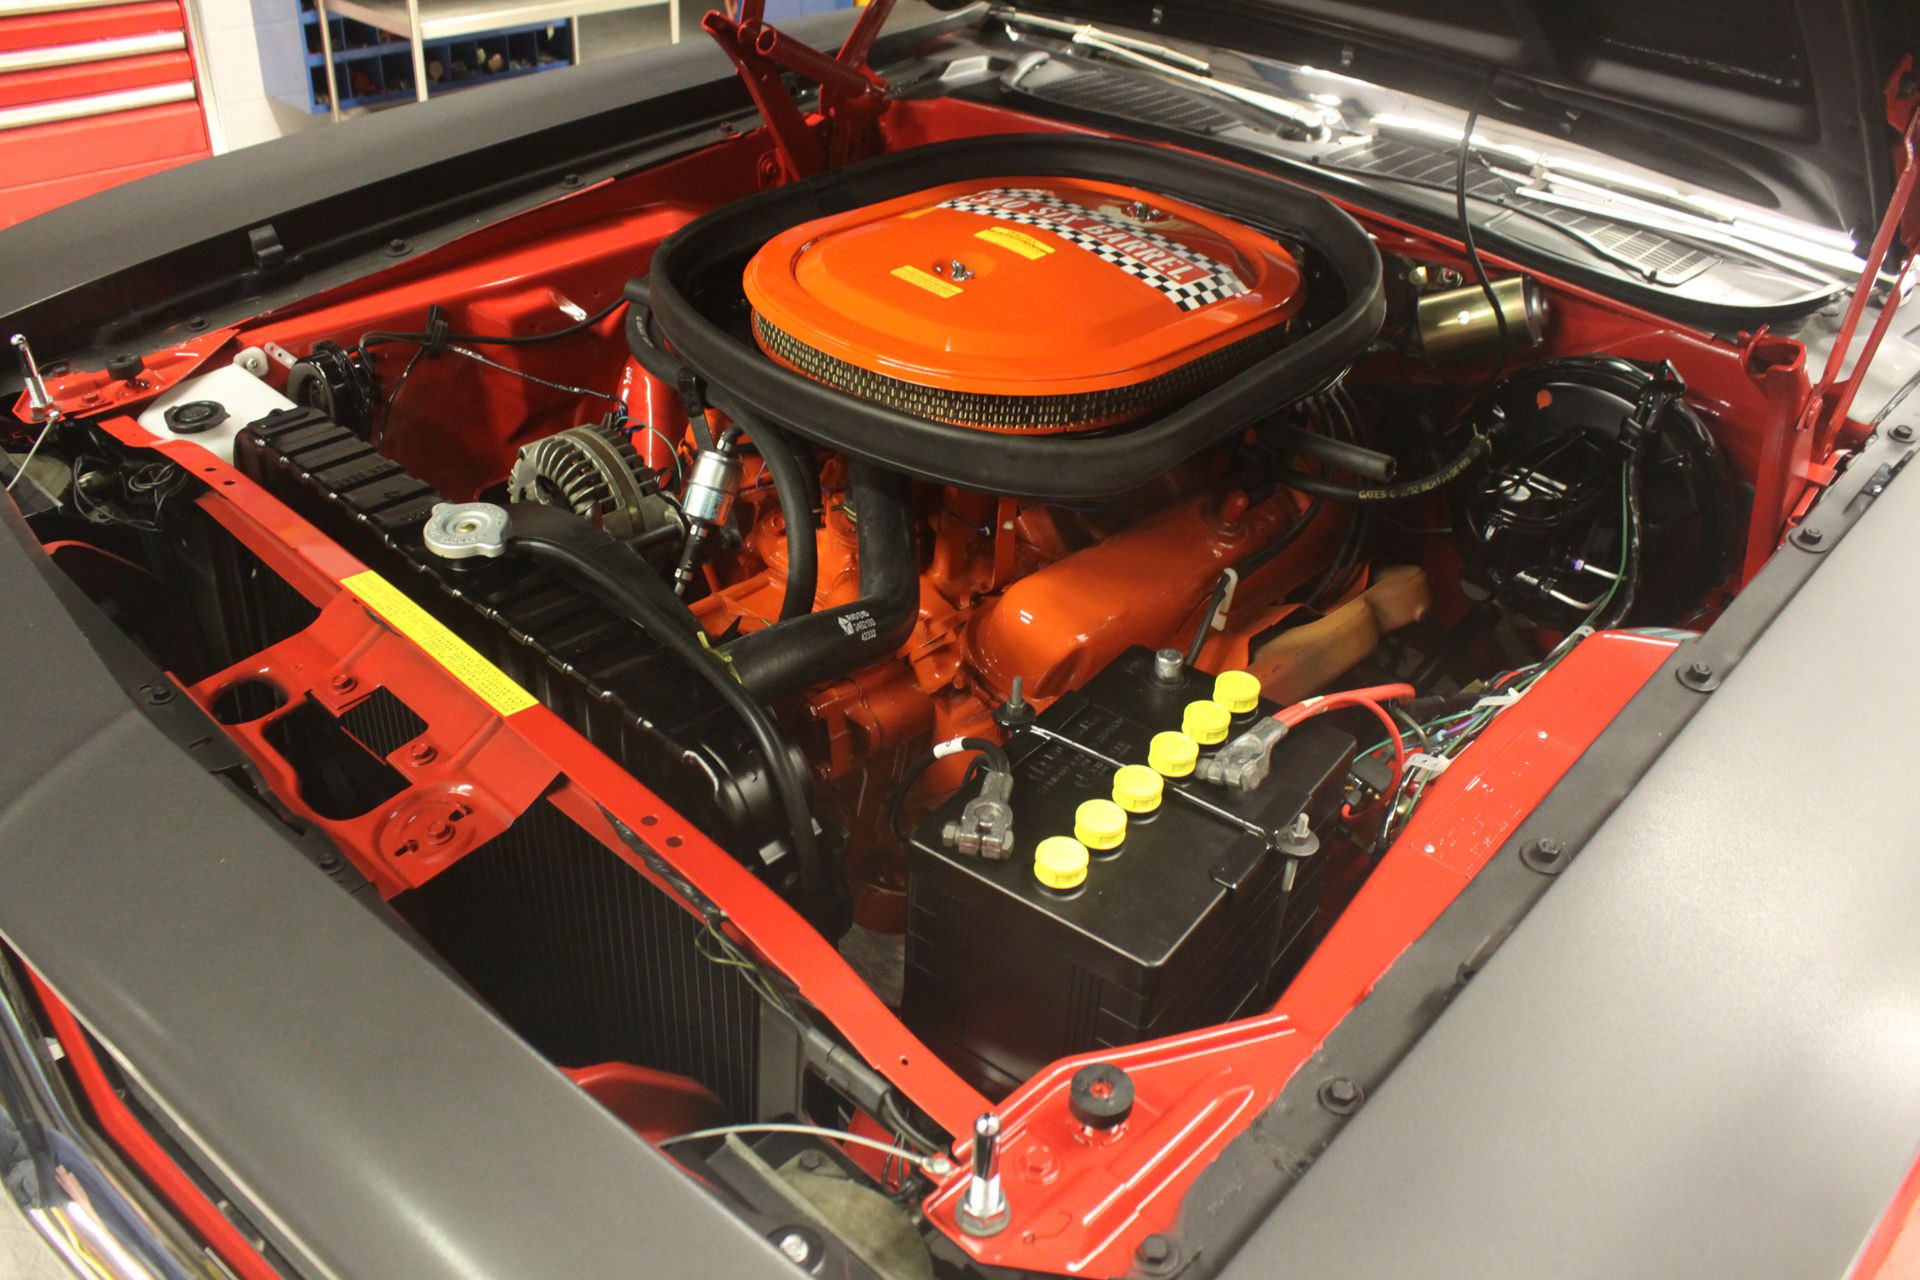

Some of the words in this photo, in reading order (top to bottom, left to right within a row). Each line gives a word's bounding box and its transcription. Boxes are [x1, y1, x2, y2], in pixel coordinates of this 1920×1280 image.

[968, 193, 1030, 209] 340
[1028, 206, 1086, 224] SIX
[1081, 224, 1194, 281] BARREL
[1358, 489, 1387, 499] GATES
